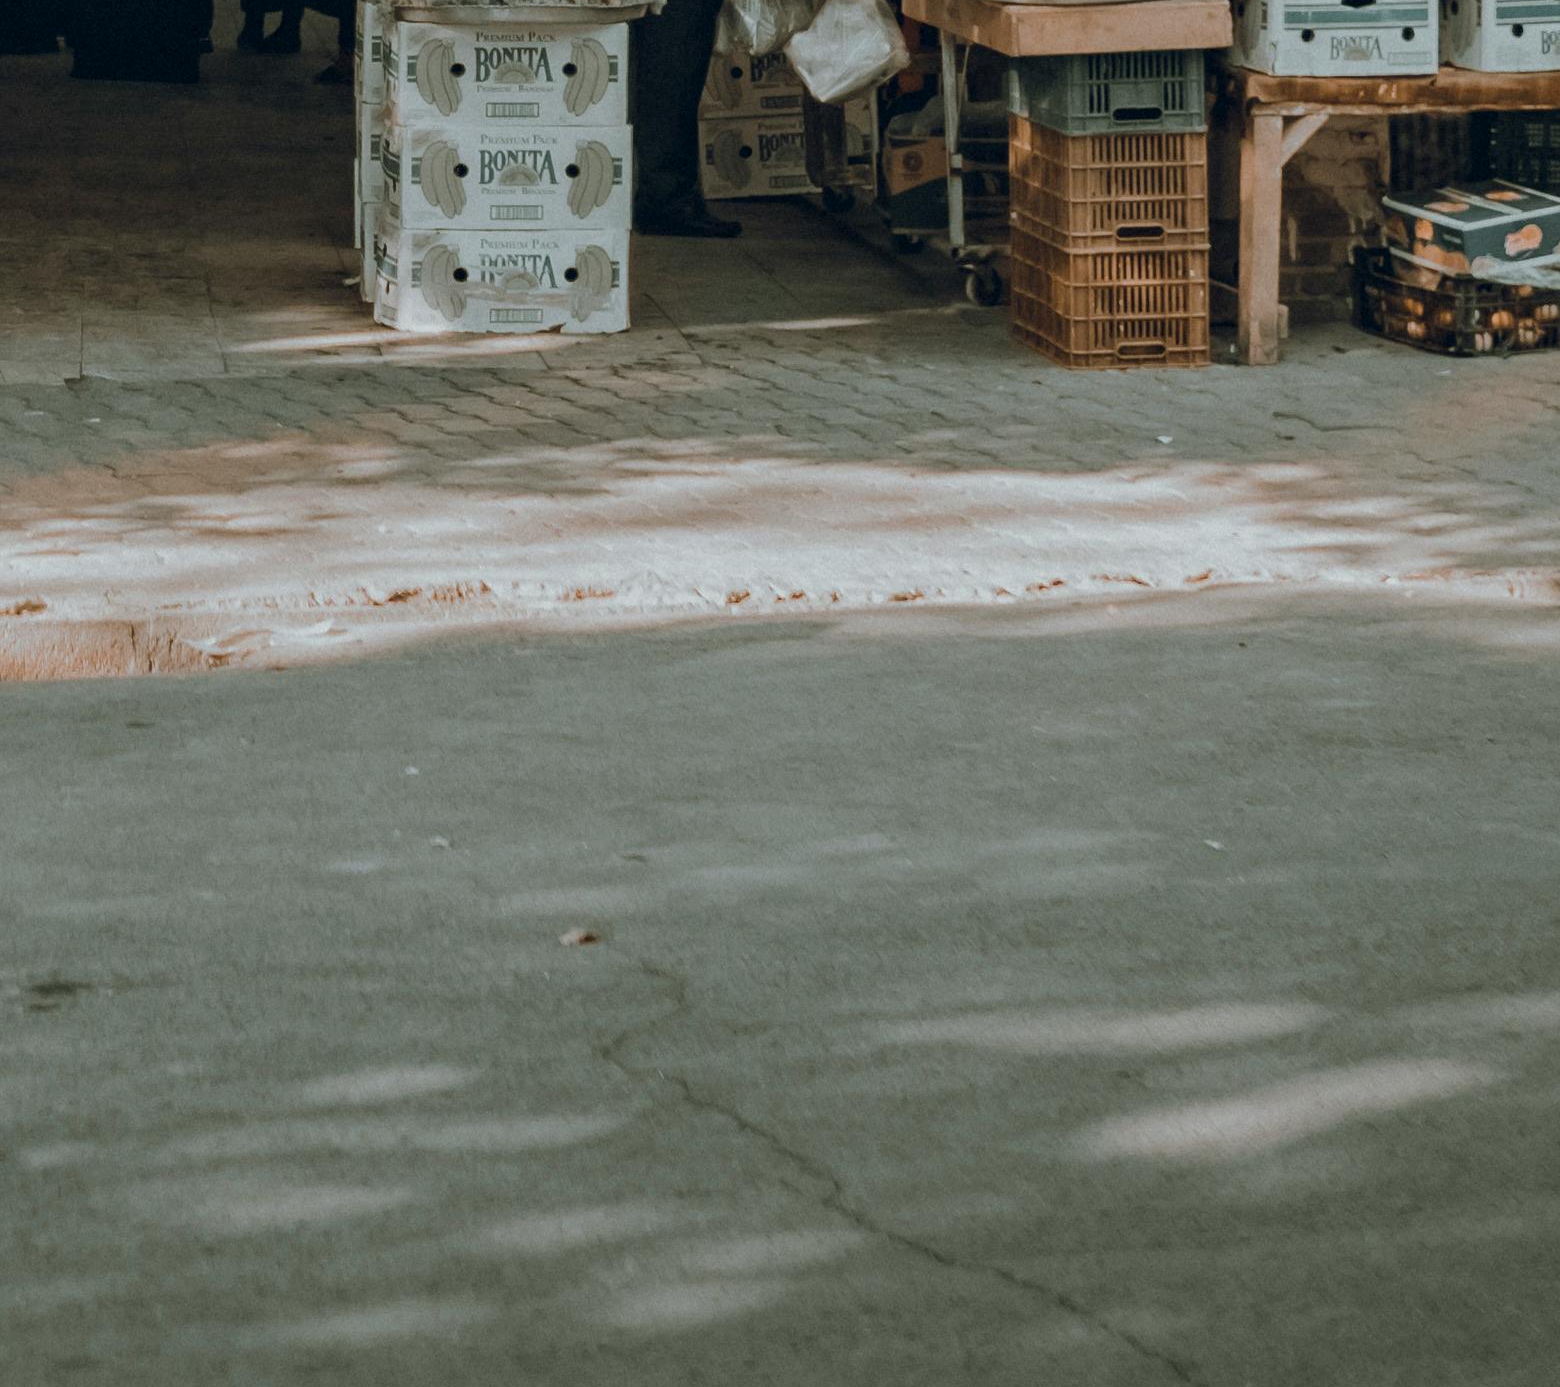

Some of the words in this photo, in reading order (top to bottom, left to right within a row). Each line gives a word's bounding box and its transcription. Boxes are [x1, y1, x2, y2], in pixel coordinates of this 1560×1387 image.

[474, 47, 554, 82] BONITA
[1330, 35, 1384, 61] BONITA
[478, 149, 559, 185] BONITA
